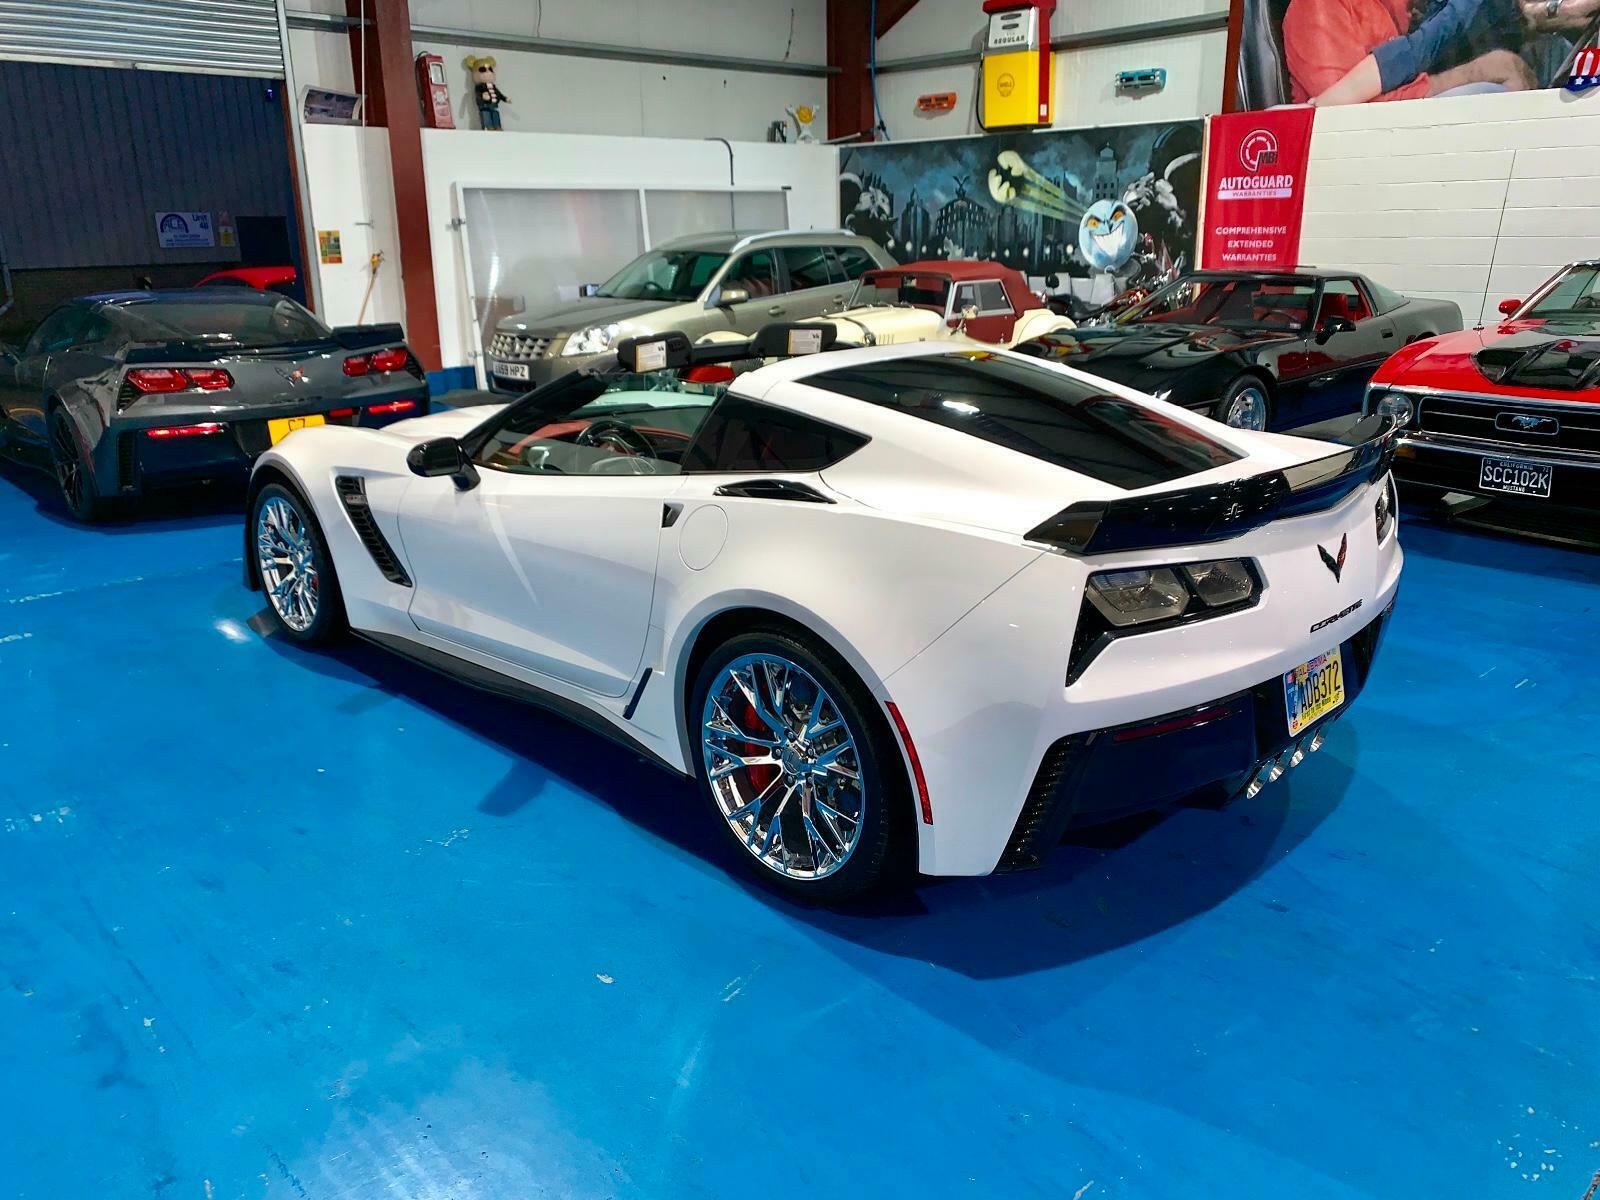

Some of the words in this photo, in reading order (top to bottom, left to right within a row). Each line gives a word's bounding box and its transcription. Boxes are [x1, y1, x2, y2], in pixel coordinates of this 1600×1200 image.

[994, 35, 1024, 44] REGULAR
[1219, 175, 1293, 190] AUTOGUARD
[1215, 226, 1287, 235] COMPREHENSIVE
[1227, 240, 1274, 248] EXTENDED
[1222, 253, 1277, 261] WARRANTIES
[1484, 466, 1549, 489] SCC102K
[1502, 484, 1526, 493] MUSTANG
[1310, 599, 1363, 633] CORVETTE
[1298, 660, 1341, 714] ADB372
